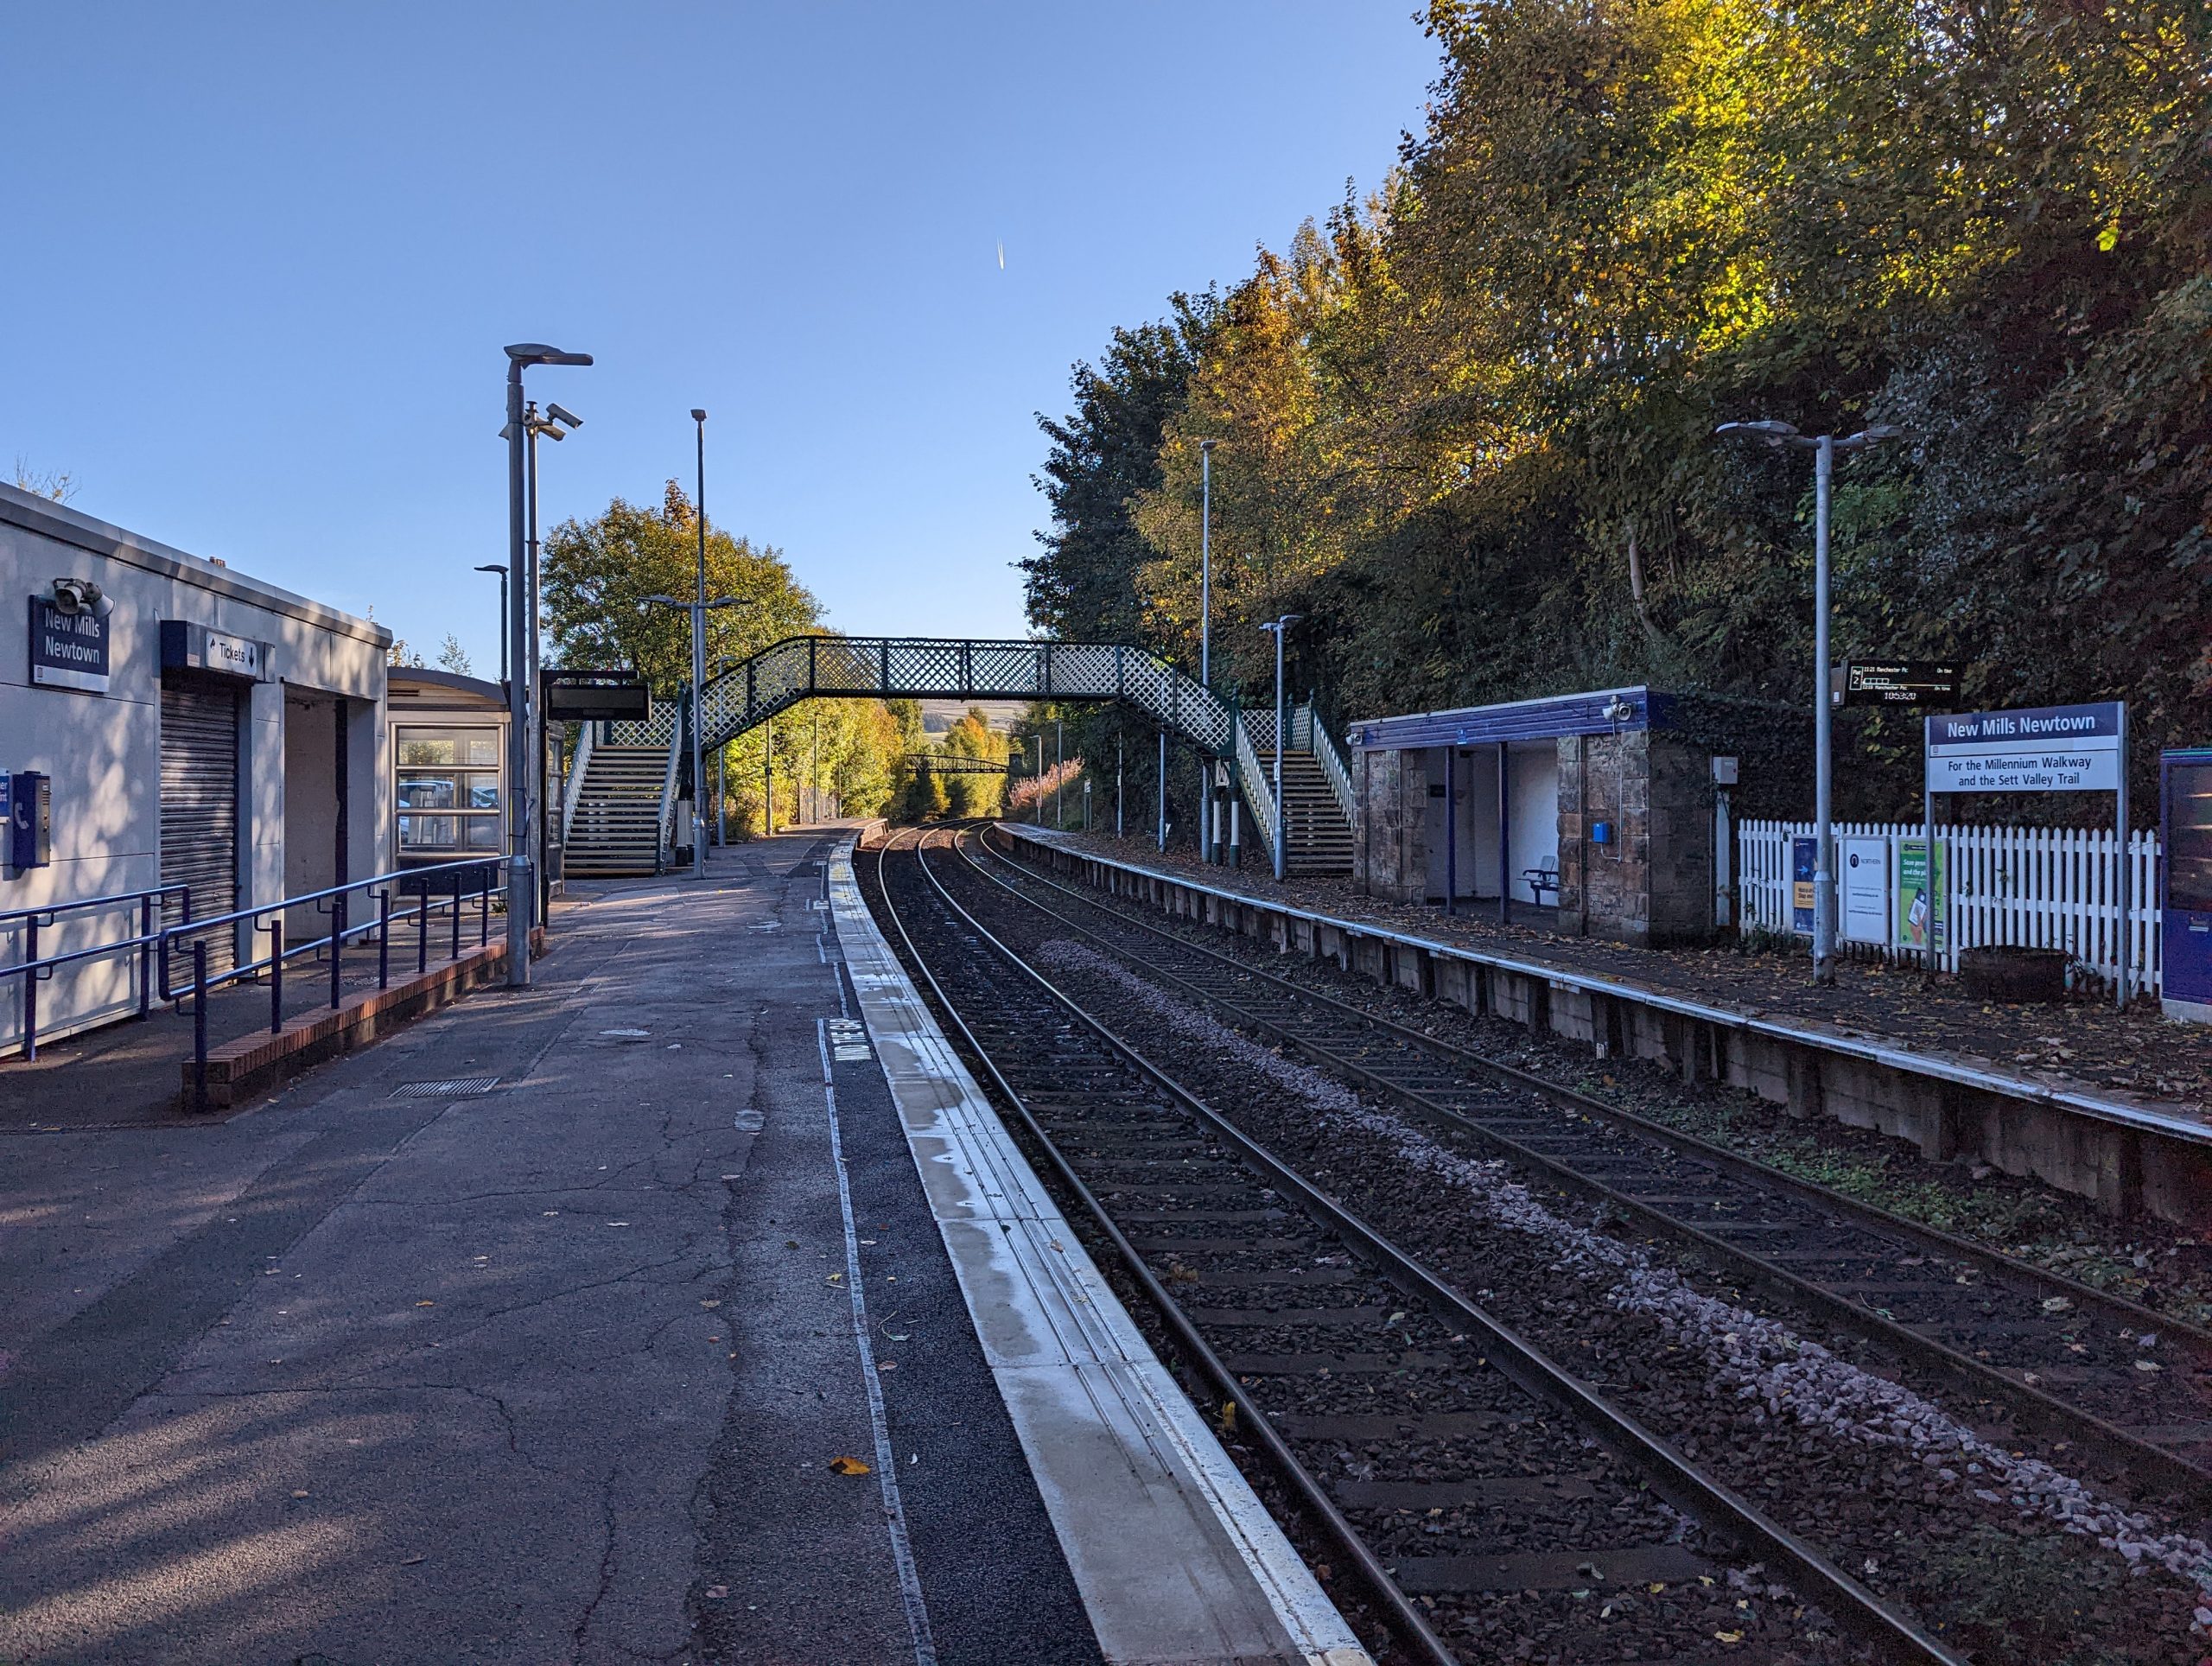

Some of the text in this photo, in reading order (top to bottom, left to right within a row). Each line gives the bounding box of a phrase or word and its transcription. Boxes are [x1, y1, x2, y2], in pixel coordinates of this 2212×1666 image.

[45, 607, 100, 638] New Mills
[45, 635, 100, 664] Newtown
[219, 642, 245, 663] Tickets
[1853, 676, 1859, 684] 2
[1948, 715, 2095, 738] New Mills Newtown
[1948, 756, 2092, 772] For the Millennium Walkway
[1959, 772, 2080, 787] and the Sett Valley Trail
[830, 1031, 868, 1045] THE
